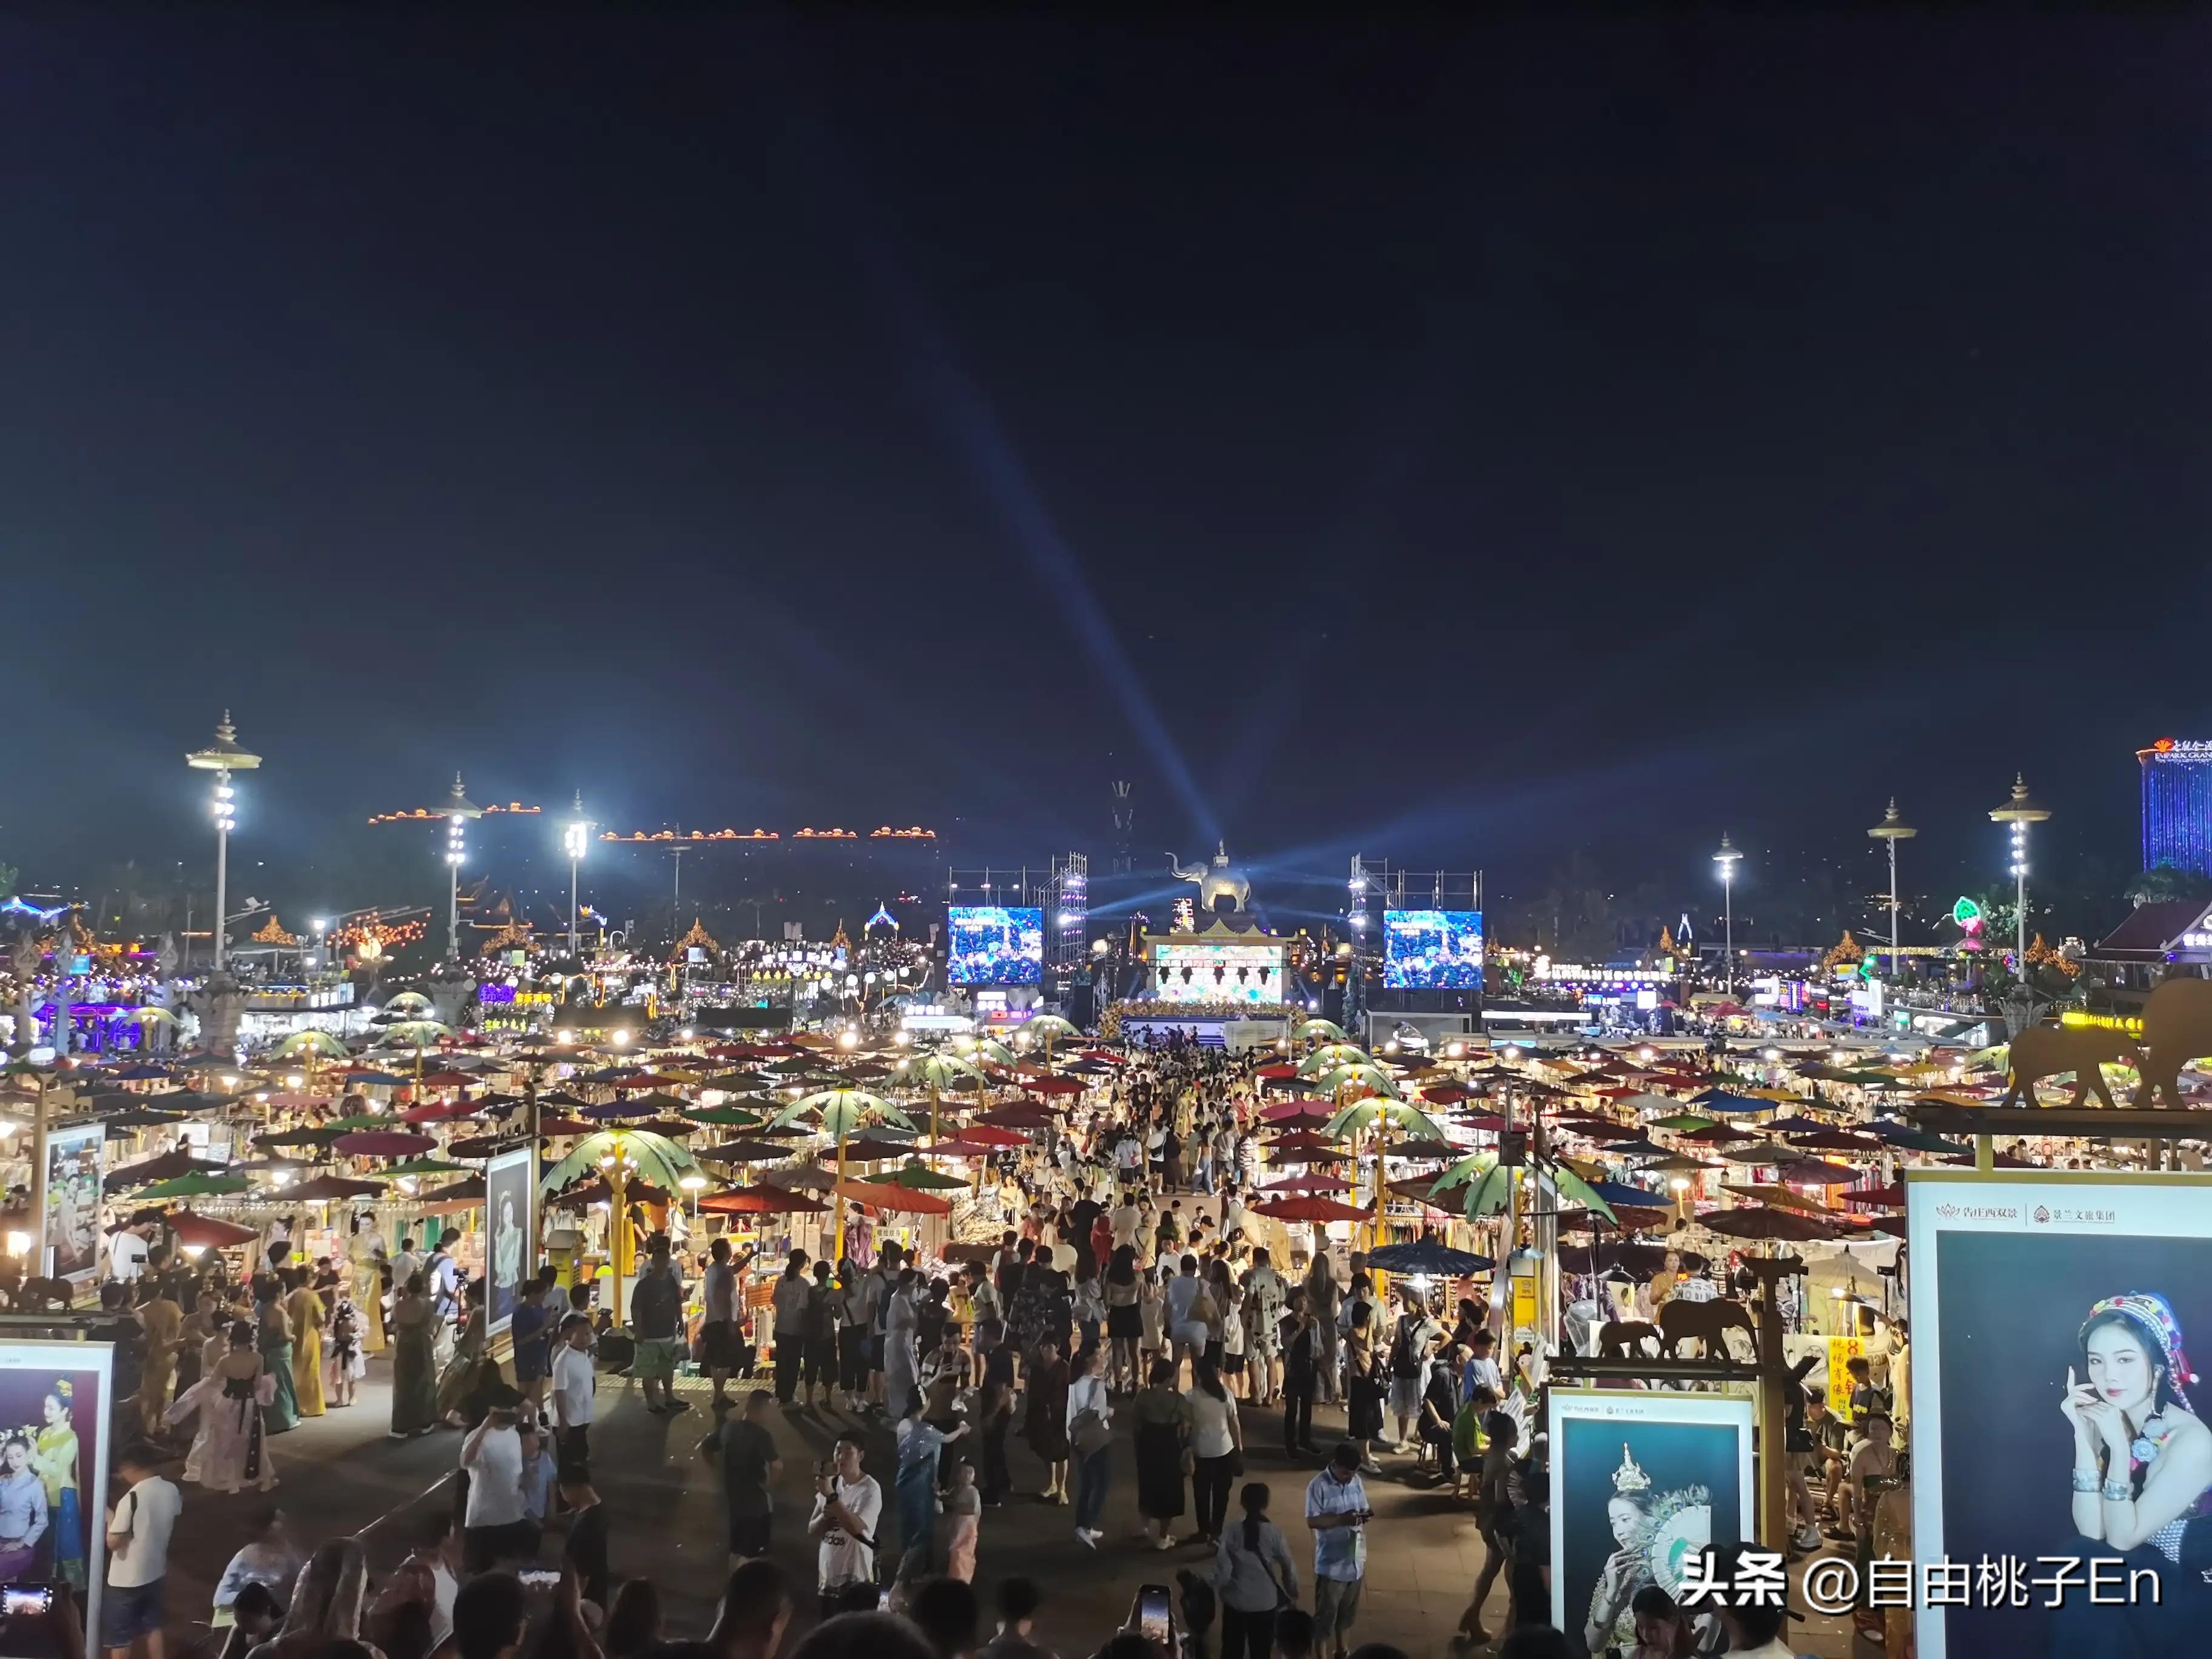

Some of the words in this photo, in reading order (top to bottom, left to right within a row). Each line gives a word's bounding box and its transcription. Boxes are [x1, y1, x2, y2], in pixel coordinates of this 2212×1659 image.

[1963, 1206, 2018, 1219] 告庄西双景
[2053, 1210, 2115, 1221] 景兰文旅集团
